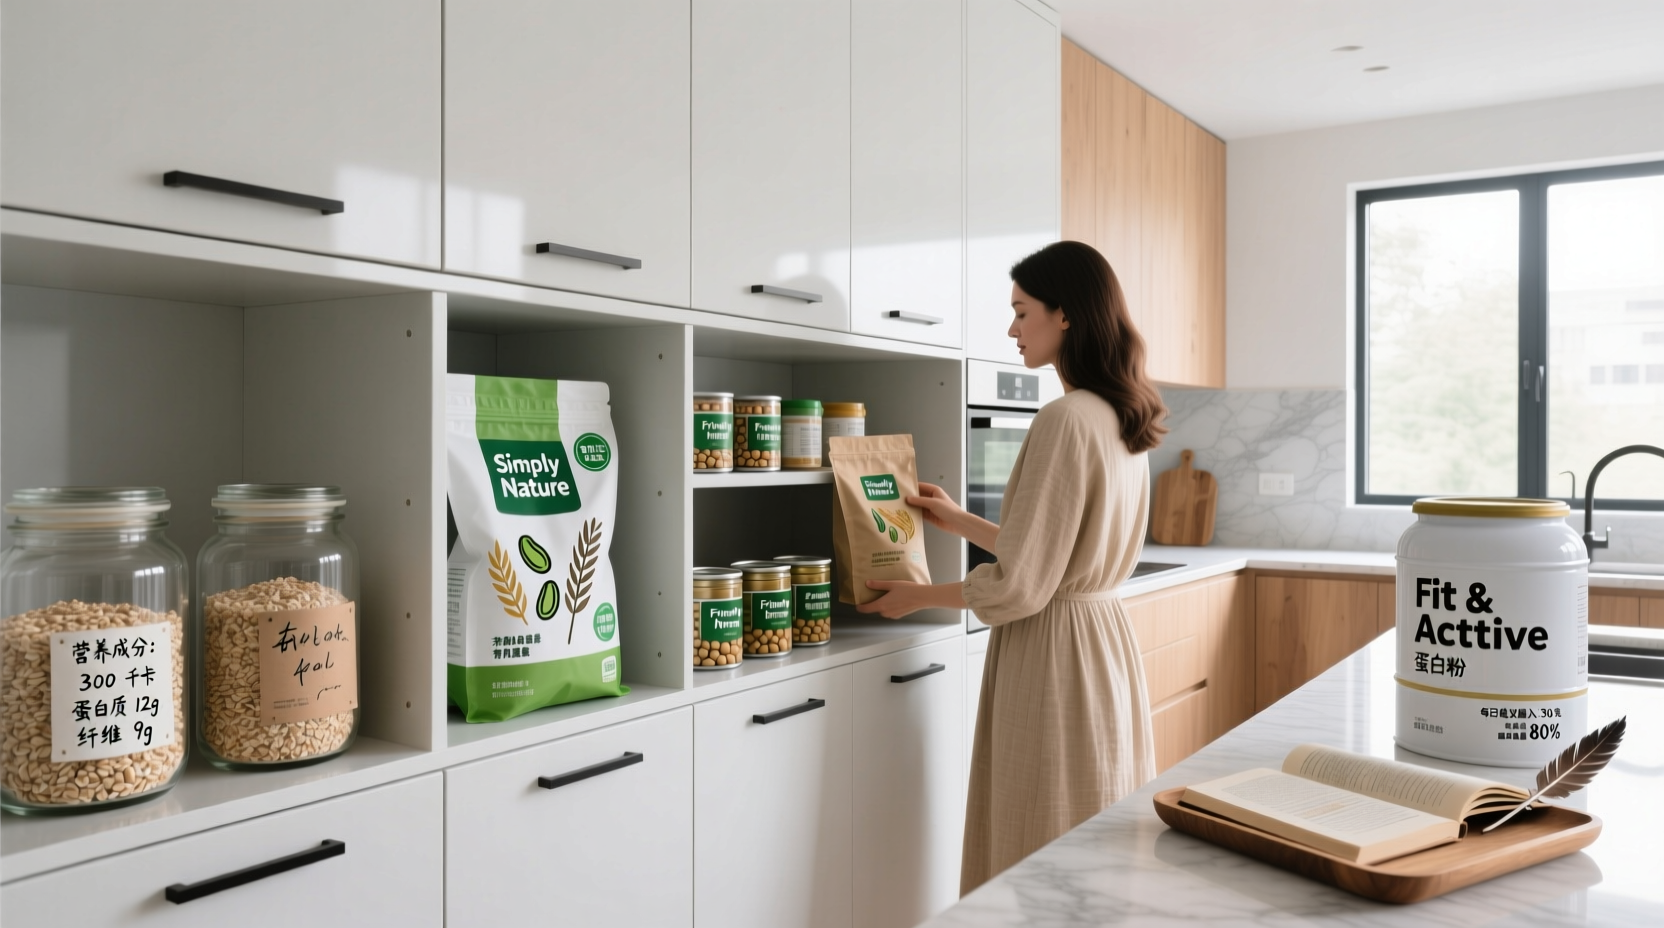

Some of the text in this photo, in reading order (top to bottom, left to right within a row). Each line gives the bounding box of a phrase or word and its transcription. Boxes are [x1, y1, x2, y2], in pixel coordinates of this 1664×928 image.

[493, 453, 559, 478] Simply
[500, 477, 570, 498] Nature
[1416, 577, 1493, 614] Fit &
[1414, 614, 1549, 651] Acttive
[1414, 651, 1466, 678] 蛋白粉
[79, 665, 156, 692] 300 千卡
[71, 695, 159, 722] 蛋白质 12g
[77, 720, 153, 749] 纤维 9g
[1529, 723, 1561, 740] 80%
